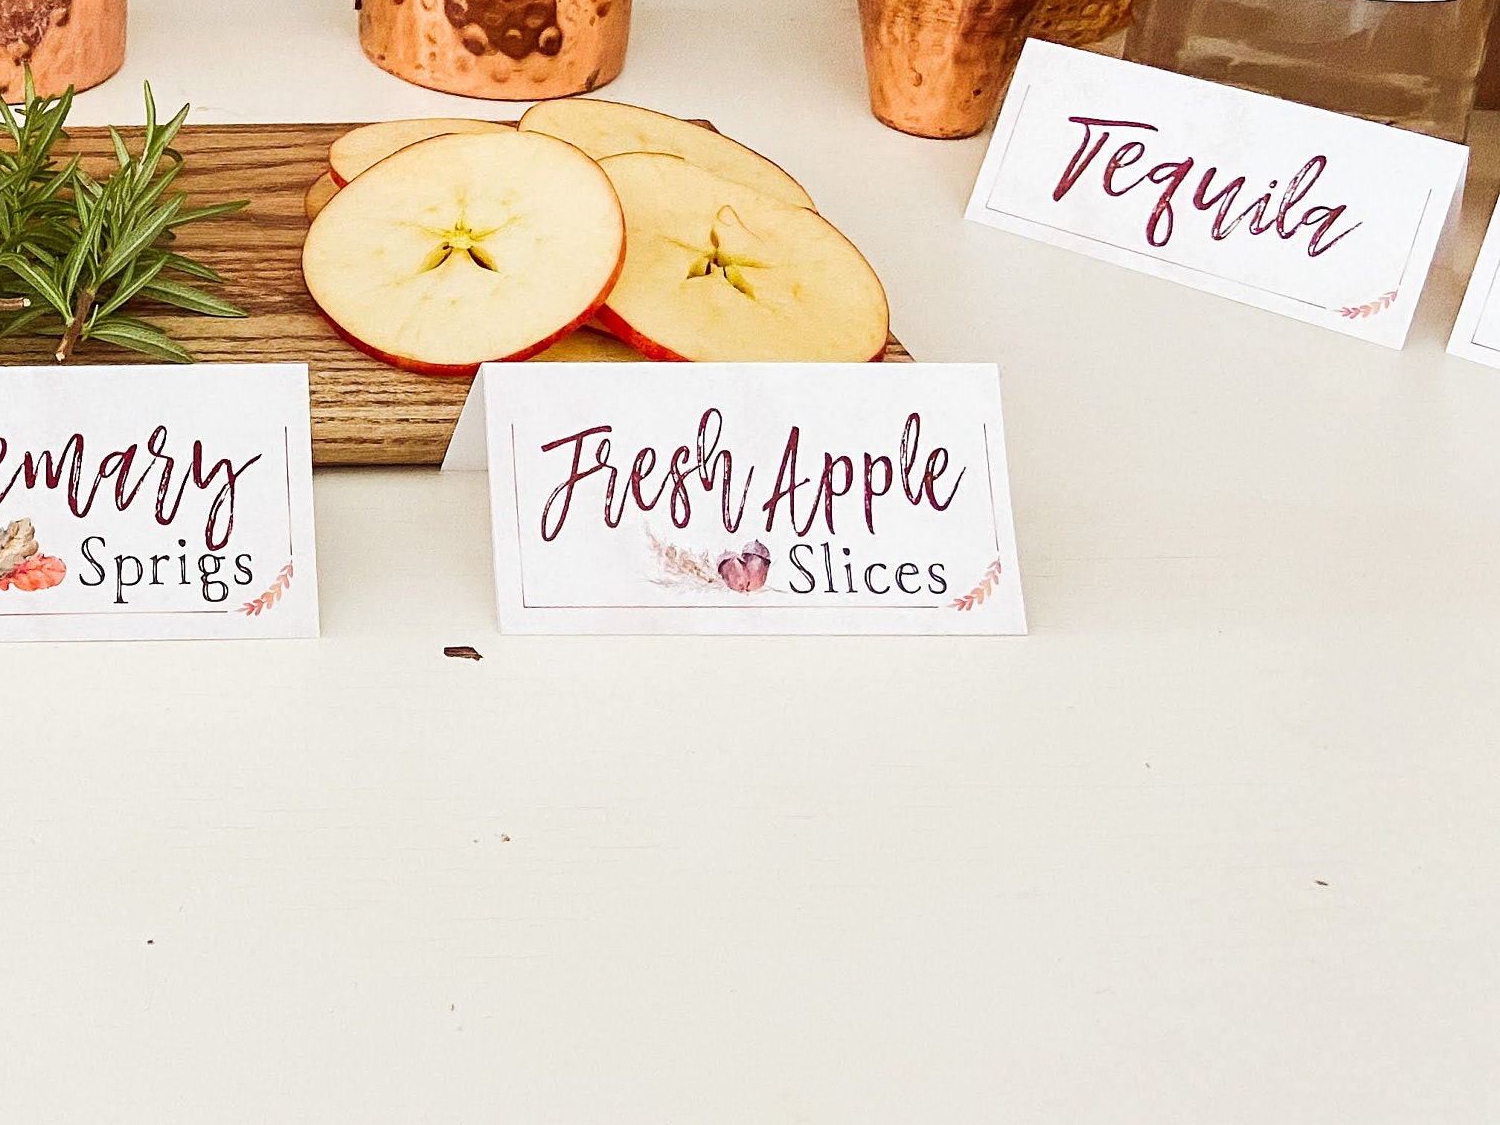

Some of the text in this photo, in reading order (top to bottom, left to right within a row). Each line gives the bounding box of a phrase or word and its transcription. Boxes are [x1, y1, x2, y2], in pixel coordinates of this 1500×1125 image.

[1052, 115, 1363, 257] Tequila
[541, 407, 967, 542] Fresh Apple
[78, 535, 254, 603] Sprigs
[789, 543, 949, 595] Slices
